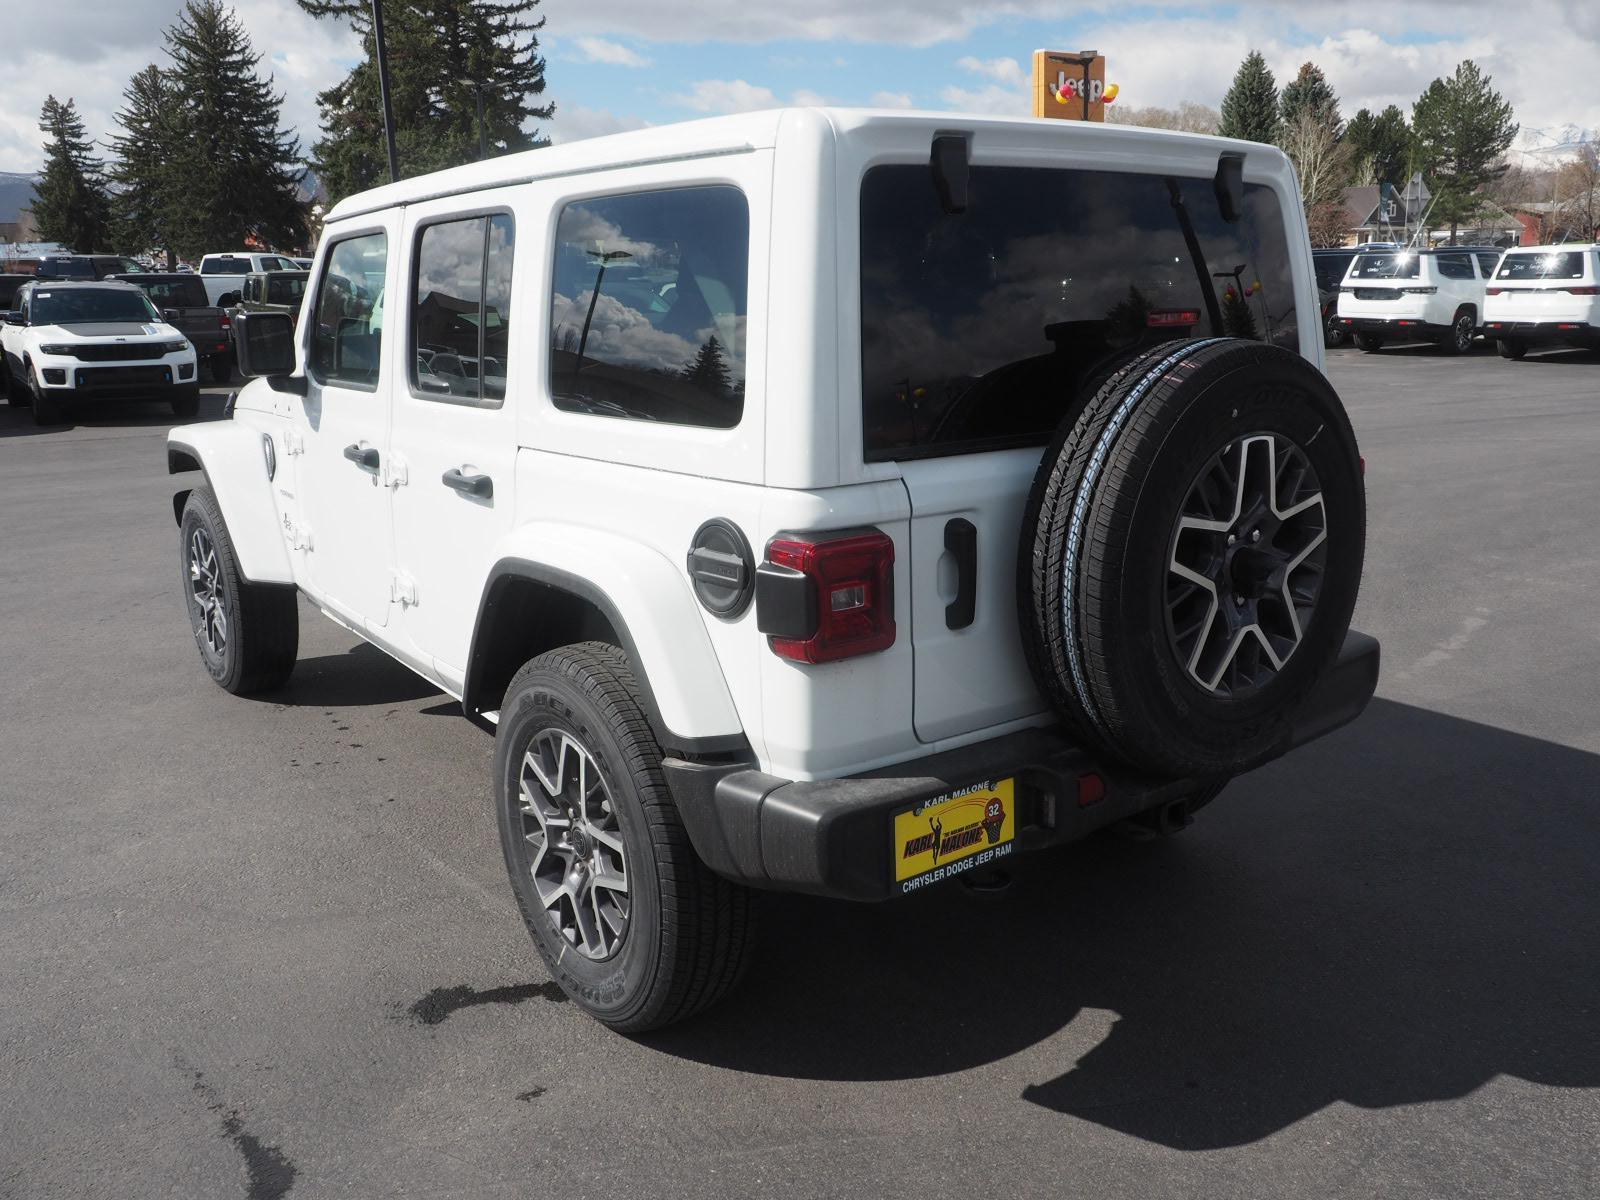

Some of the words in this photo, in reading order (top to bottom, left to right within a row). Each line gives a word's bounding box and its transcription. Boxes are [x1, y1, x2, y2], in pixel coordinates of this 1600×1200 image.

[924, 795, 950, 809] KARL
[952, 780, 990, 799] MALONE
[988, 803, 999, 817] 32
[903, 832, 935, 859] KARL
[940, 826, 984, 857] MALONE
[902, 869, 945, 893] CHRYSLER
[946, 858, 974, 877] DODGE
[975, 848, 994, 866] JEEP
[995, 843, 1012, 859] RAM
